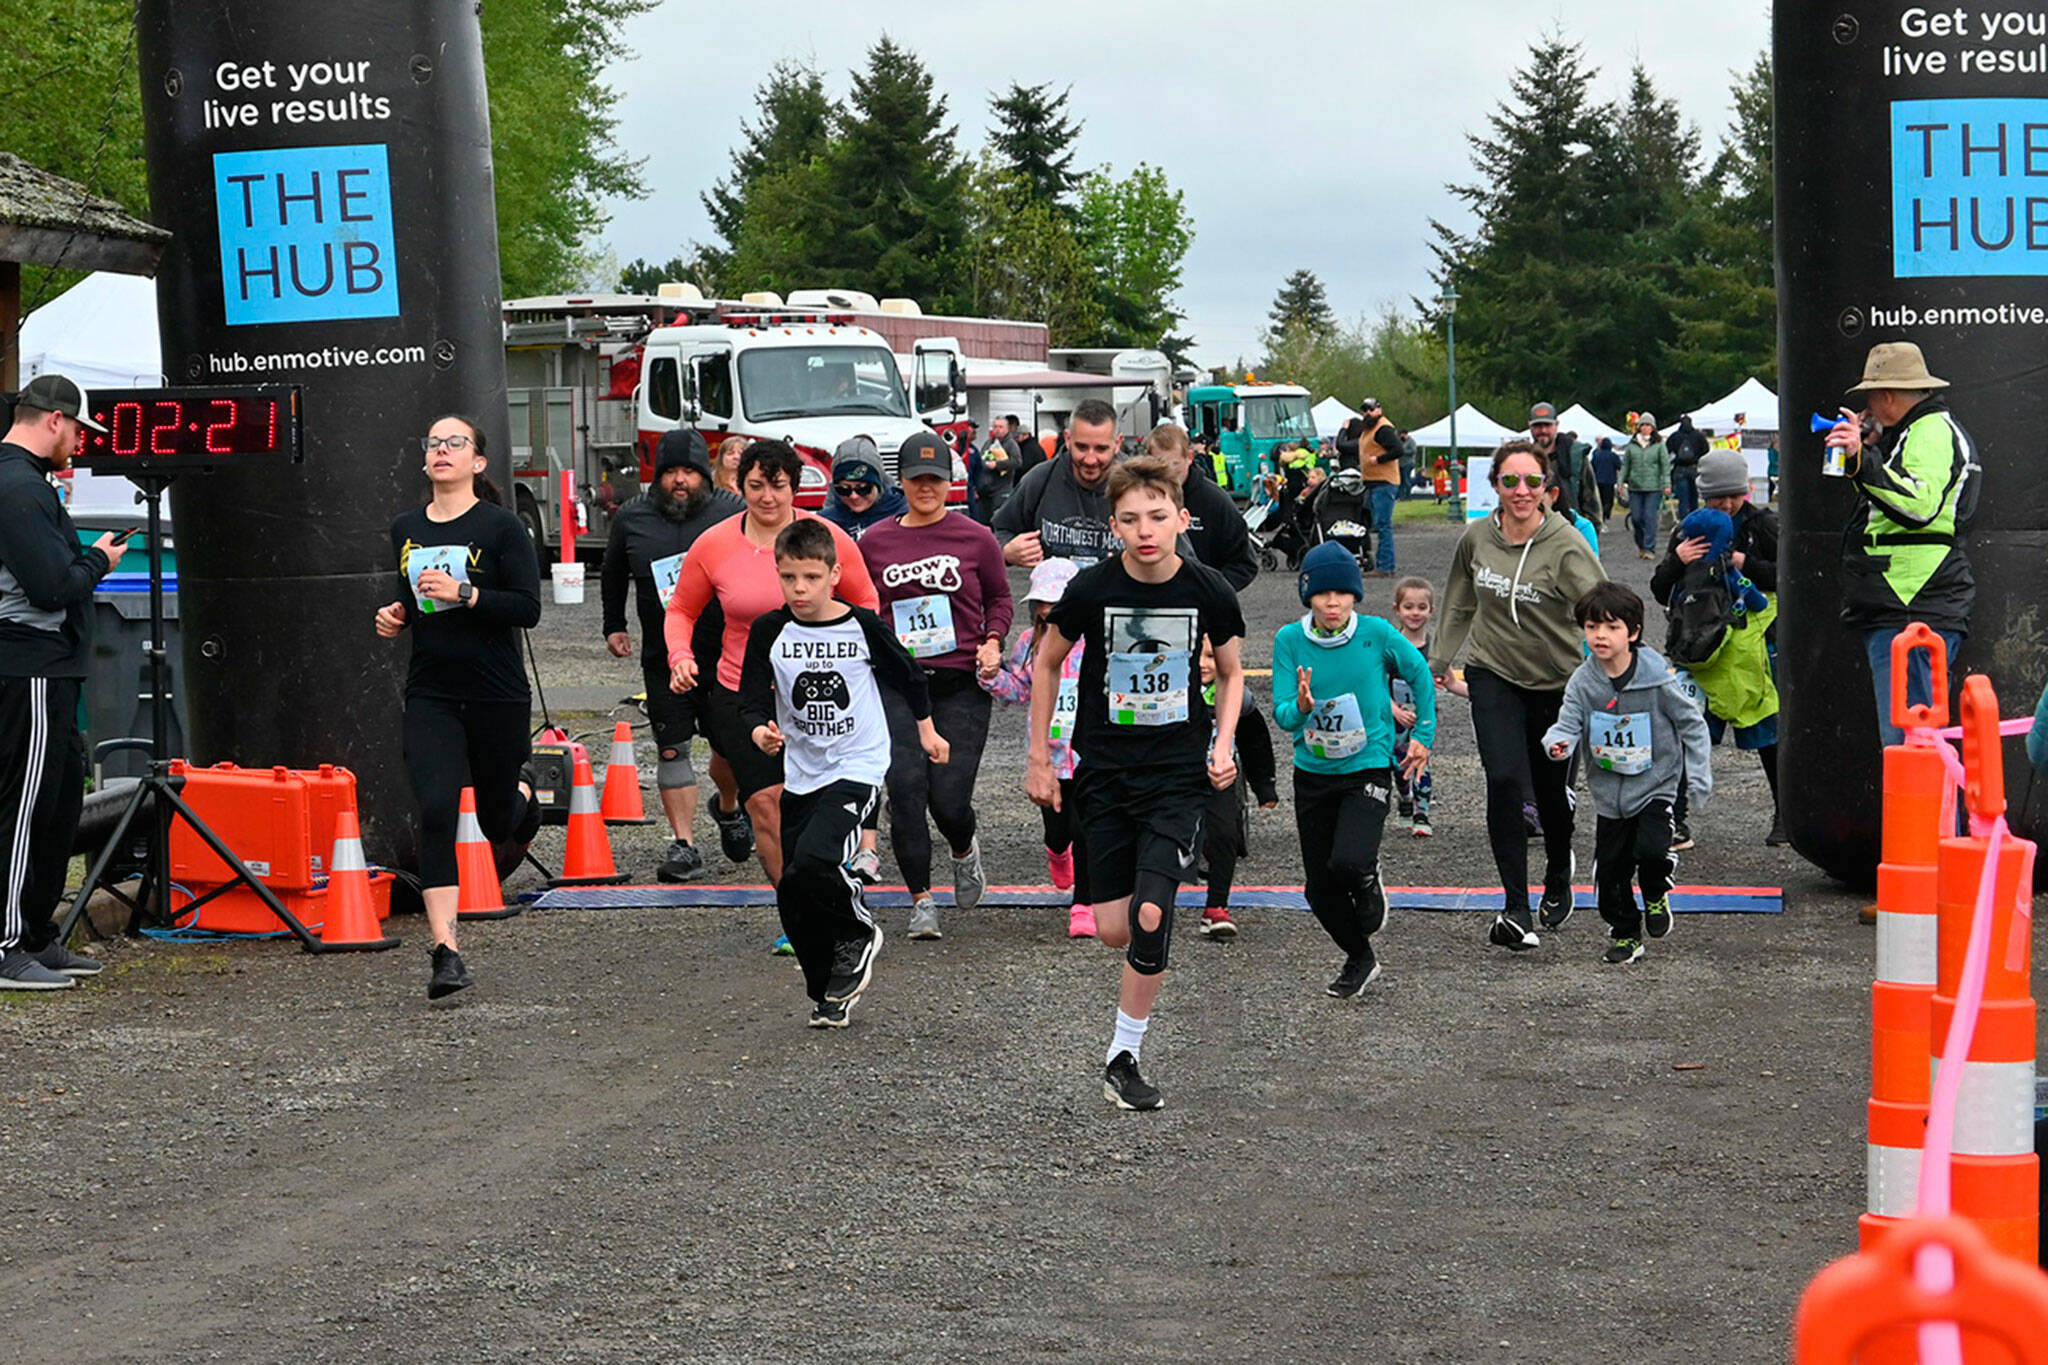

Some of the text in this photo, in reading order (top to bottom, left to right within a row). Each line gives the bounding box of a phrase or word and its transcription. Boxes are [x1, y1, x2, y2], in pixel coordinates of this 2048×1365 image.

[1900, 7, 1969, 38] Get
[1883, 46, 1948, 76] live
[215, 60, 371, 92] Get your
[203, 91, 391, 129] live results
[1905, 122, 2048, 178] THE
[226, 168, 374, 229] THE
[237, 241, 384, 301] HUB
[209, 345, 426, 374] hub.enmotive.com
[886, 559, 941, 583] Grow
[925, 573, 936, 585] a
[908, 612, 938, 632] 131
[782, 642, 858, 659] LEVELED
[822, 661, 834, 669] to
[1129, 672, 1170, 694] 138
[807, 704, 835, 721] BIG
[1314, 715, 1344, 732] 127
[1603, 731, 1636, 748] 141
